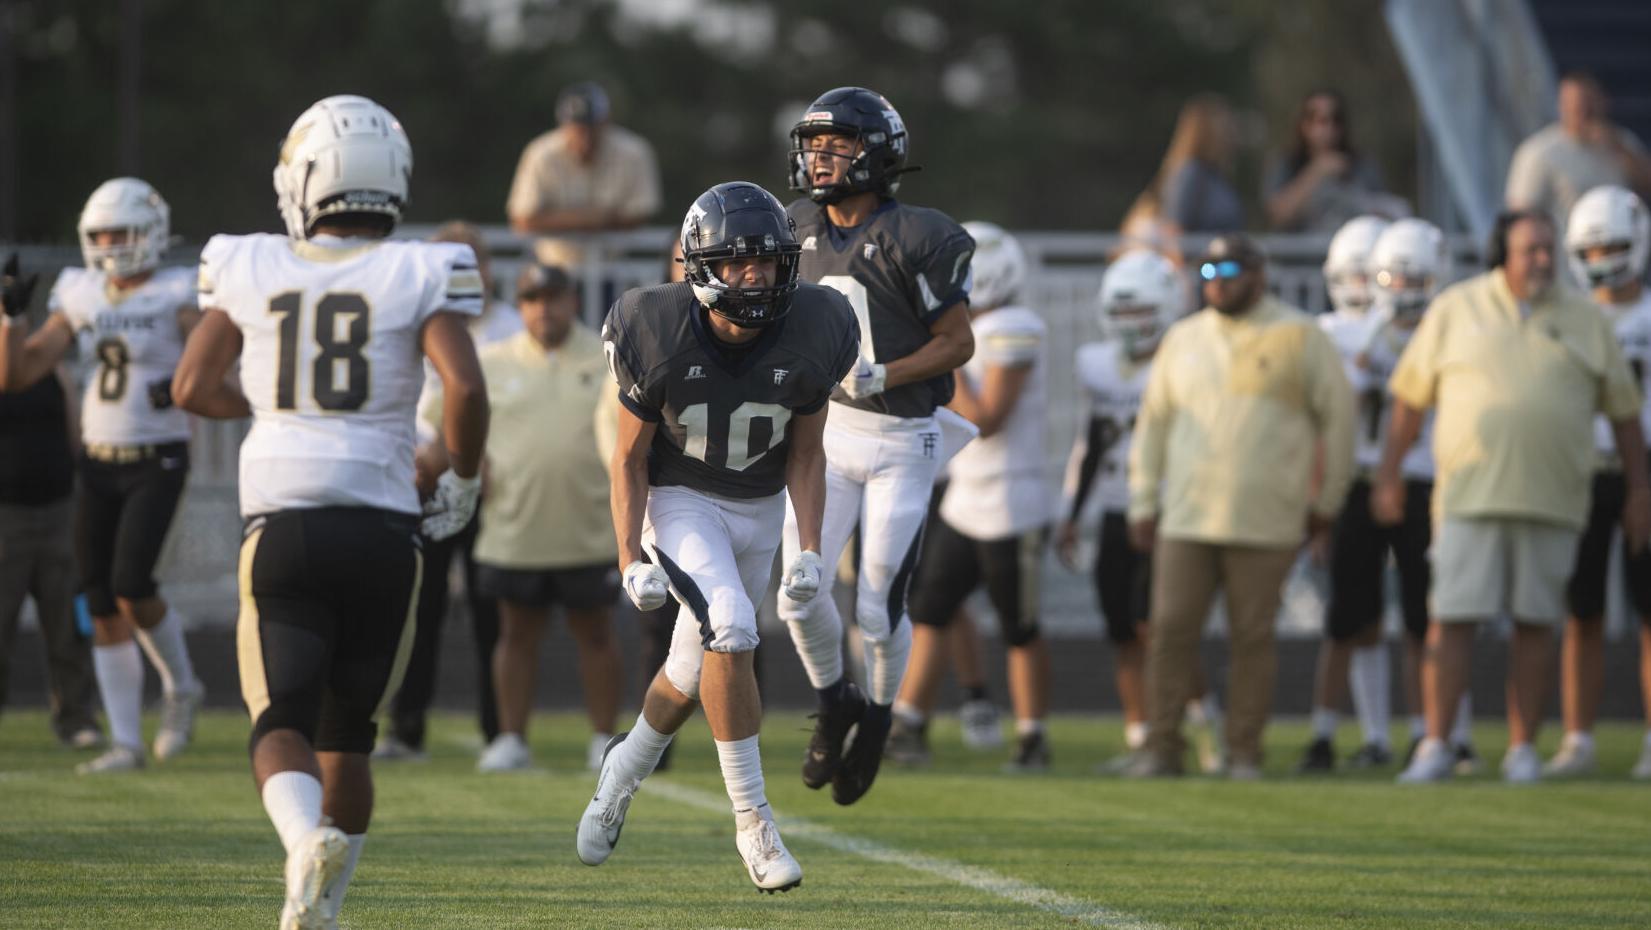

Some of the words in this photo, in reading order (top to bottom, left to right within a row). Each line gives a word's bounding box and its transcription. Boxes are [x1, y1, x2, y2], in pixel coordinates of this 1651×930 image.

[96, 336, 129, 402] 8
[268, 288, 371, 412] 18
[678, 401, 792, 472] 10
